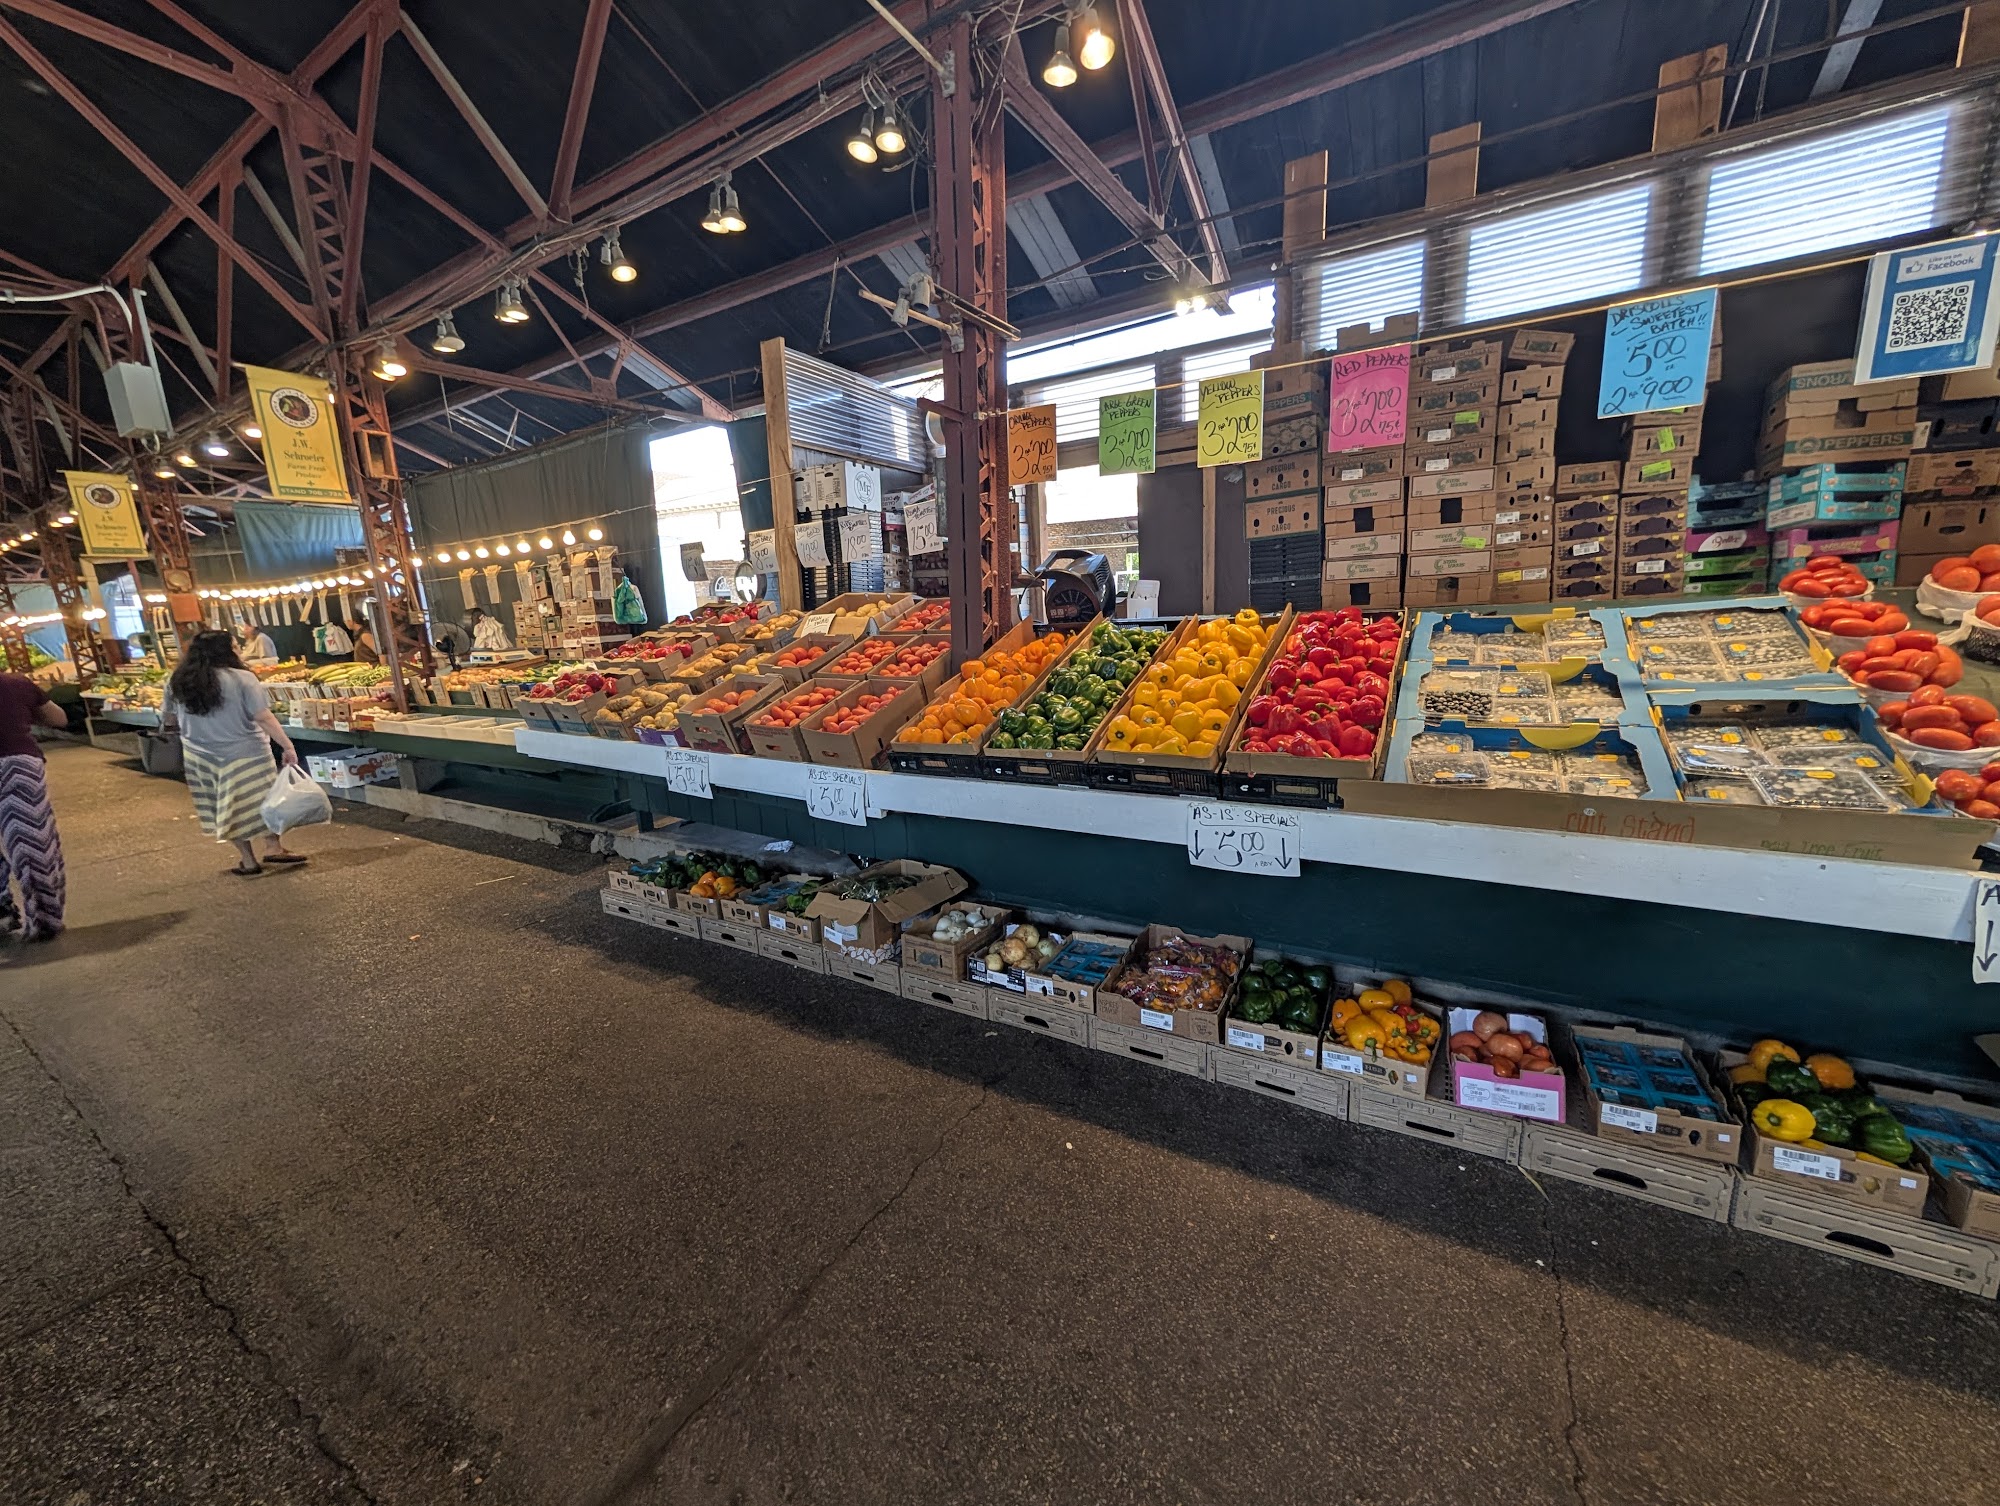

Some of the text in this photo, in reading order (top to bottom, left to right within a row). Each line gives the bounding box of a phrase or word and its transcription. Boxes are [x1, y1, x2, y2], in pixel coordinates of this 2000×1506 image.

[1926, 256, 1975, 272] Facebook
[1928, 256, 1943, 264] Like
[1629, 301, 1708, 330] SWEETEST
[1200, 378, 1236, 403] YELLOW
[1214, 384, 1261, 404] PEPPERS
[1264, 394, 1307, 410] EPPERS
[1201, 420, 1225, 456] 3
[1823, 434, 1904, 450] PEPPERS
[1101, 434, 1125, 472] 3
[1012, 444, 1030, 480] 3
[1266, 461, 1296, 474] PRECIOUS
[1271, 480, 1292, 491] CARGO
[1266, 504, 1296, 516] PRECIOUS
[1271, 522, 1291, 533] CARGO
